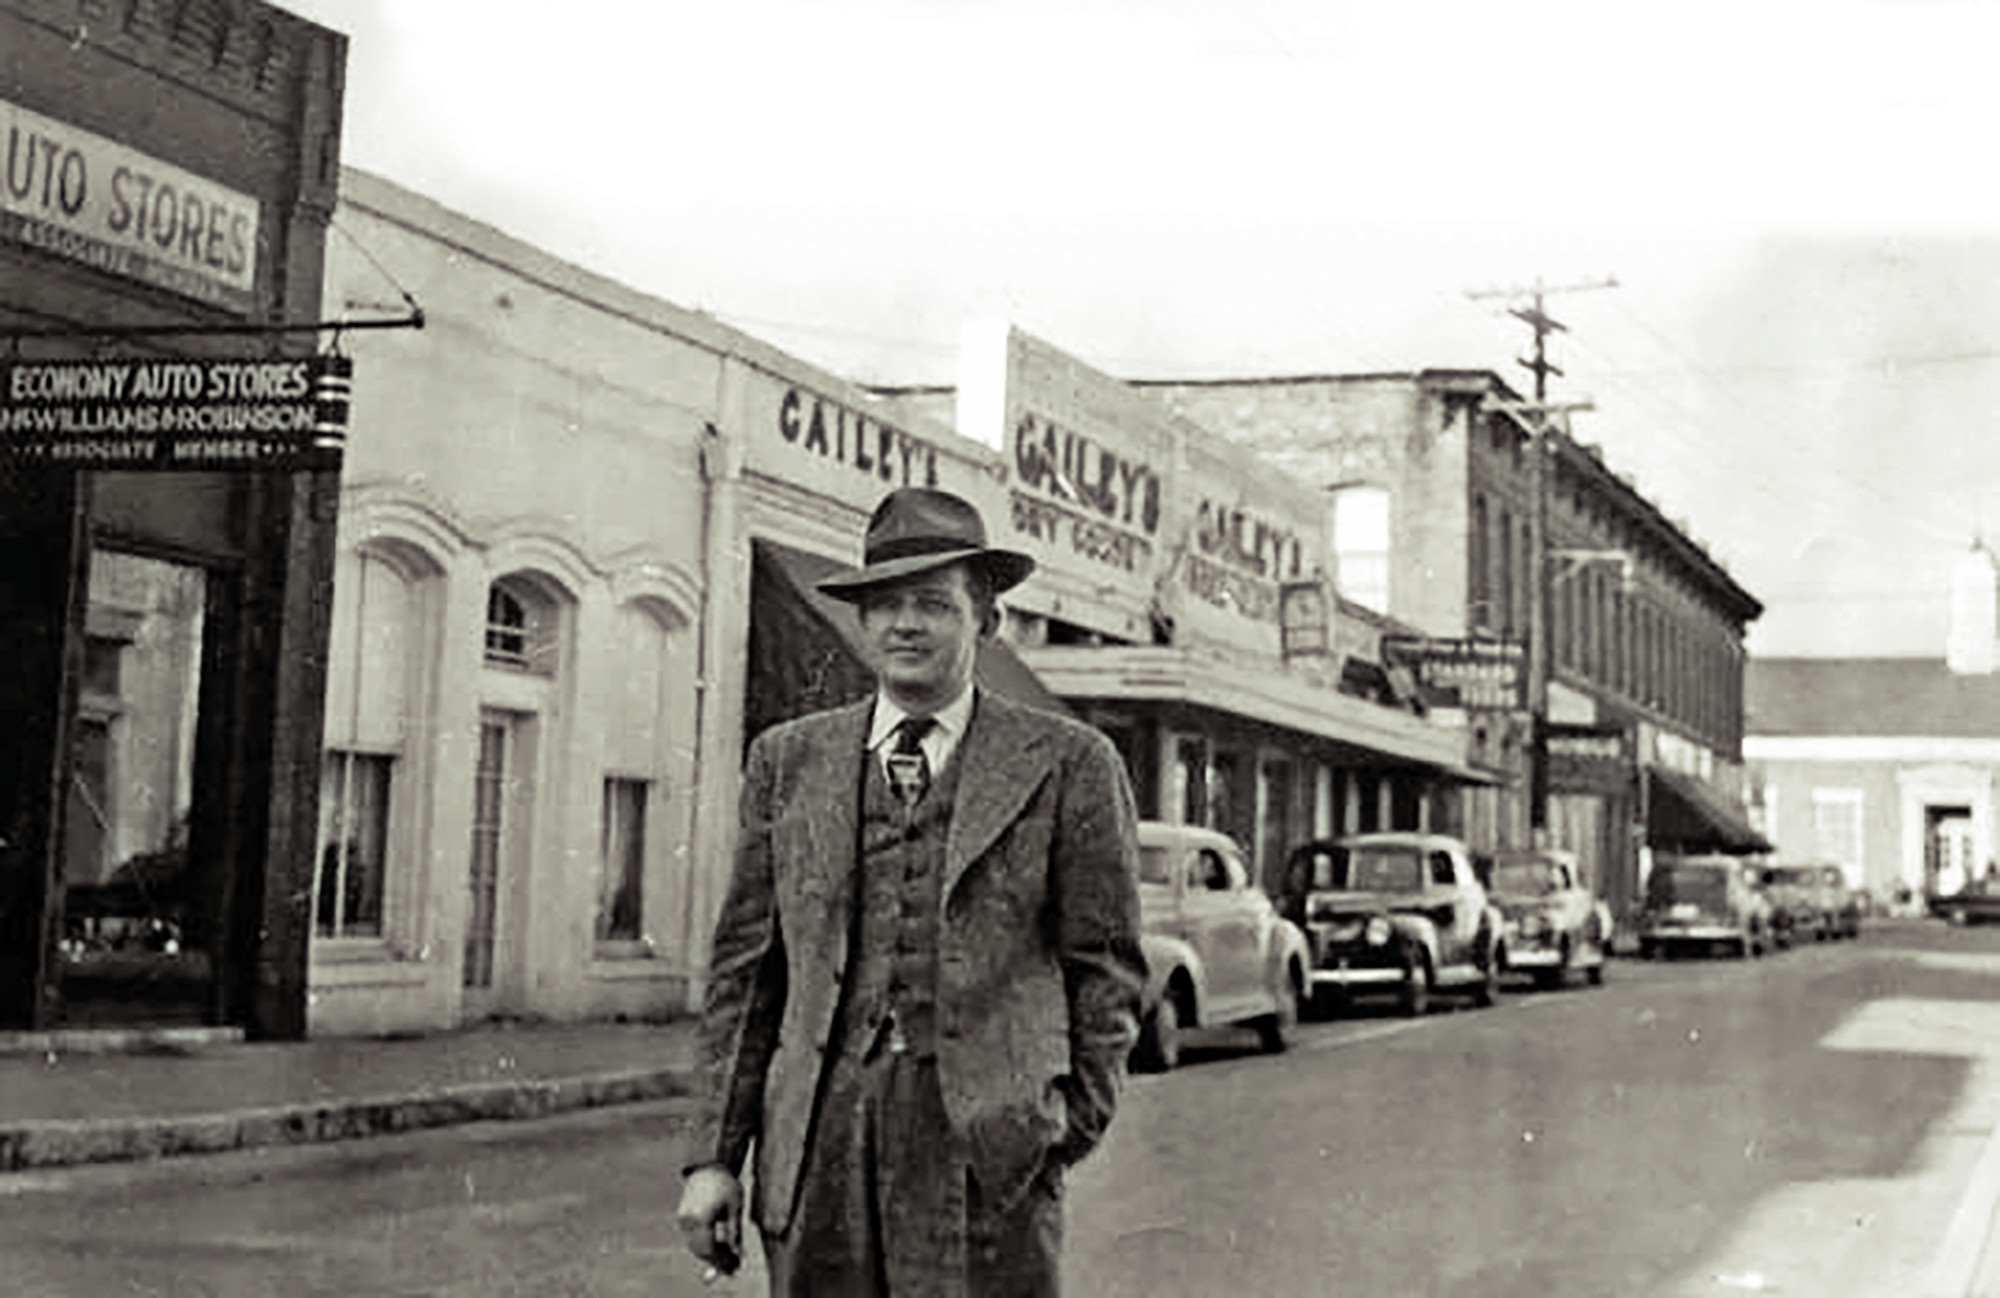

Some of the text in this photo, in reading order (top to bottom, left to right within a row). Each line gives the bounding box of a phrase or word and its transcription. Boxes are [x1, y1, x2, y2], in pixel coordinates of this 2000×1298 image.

[108, 166, 250, 275] STORES
[11, 362, 309, 399] ECONOMY AUTO STORES
